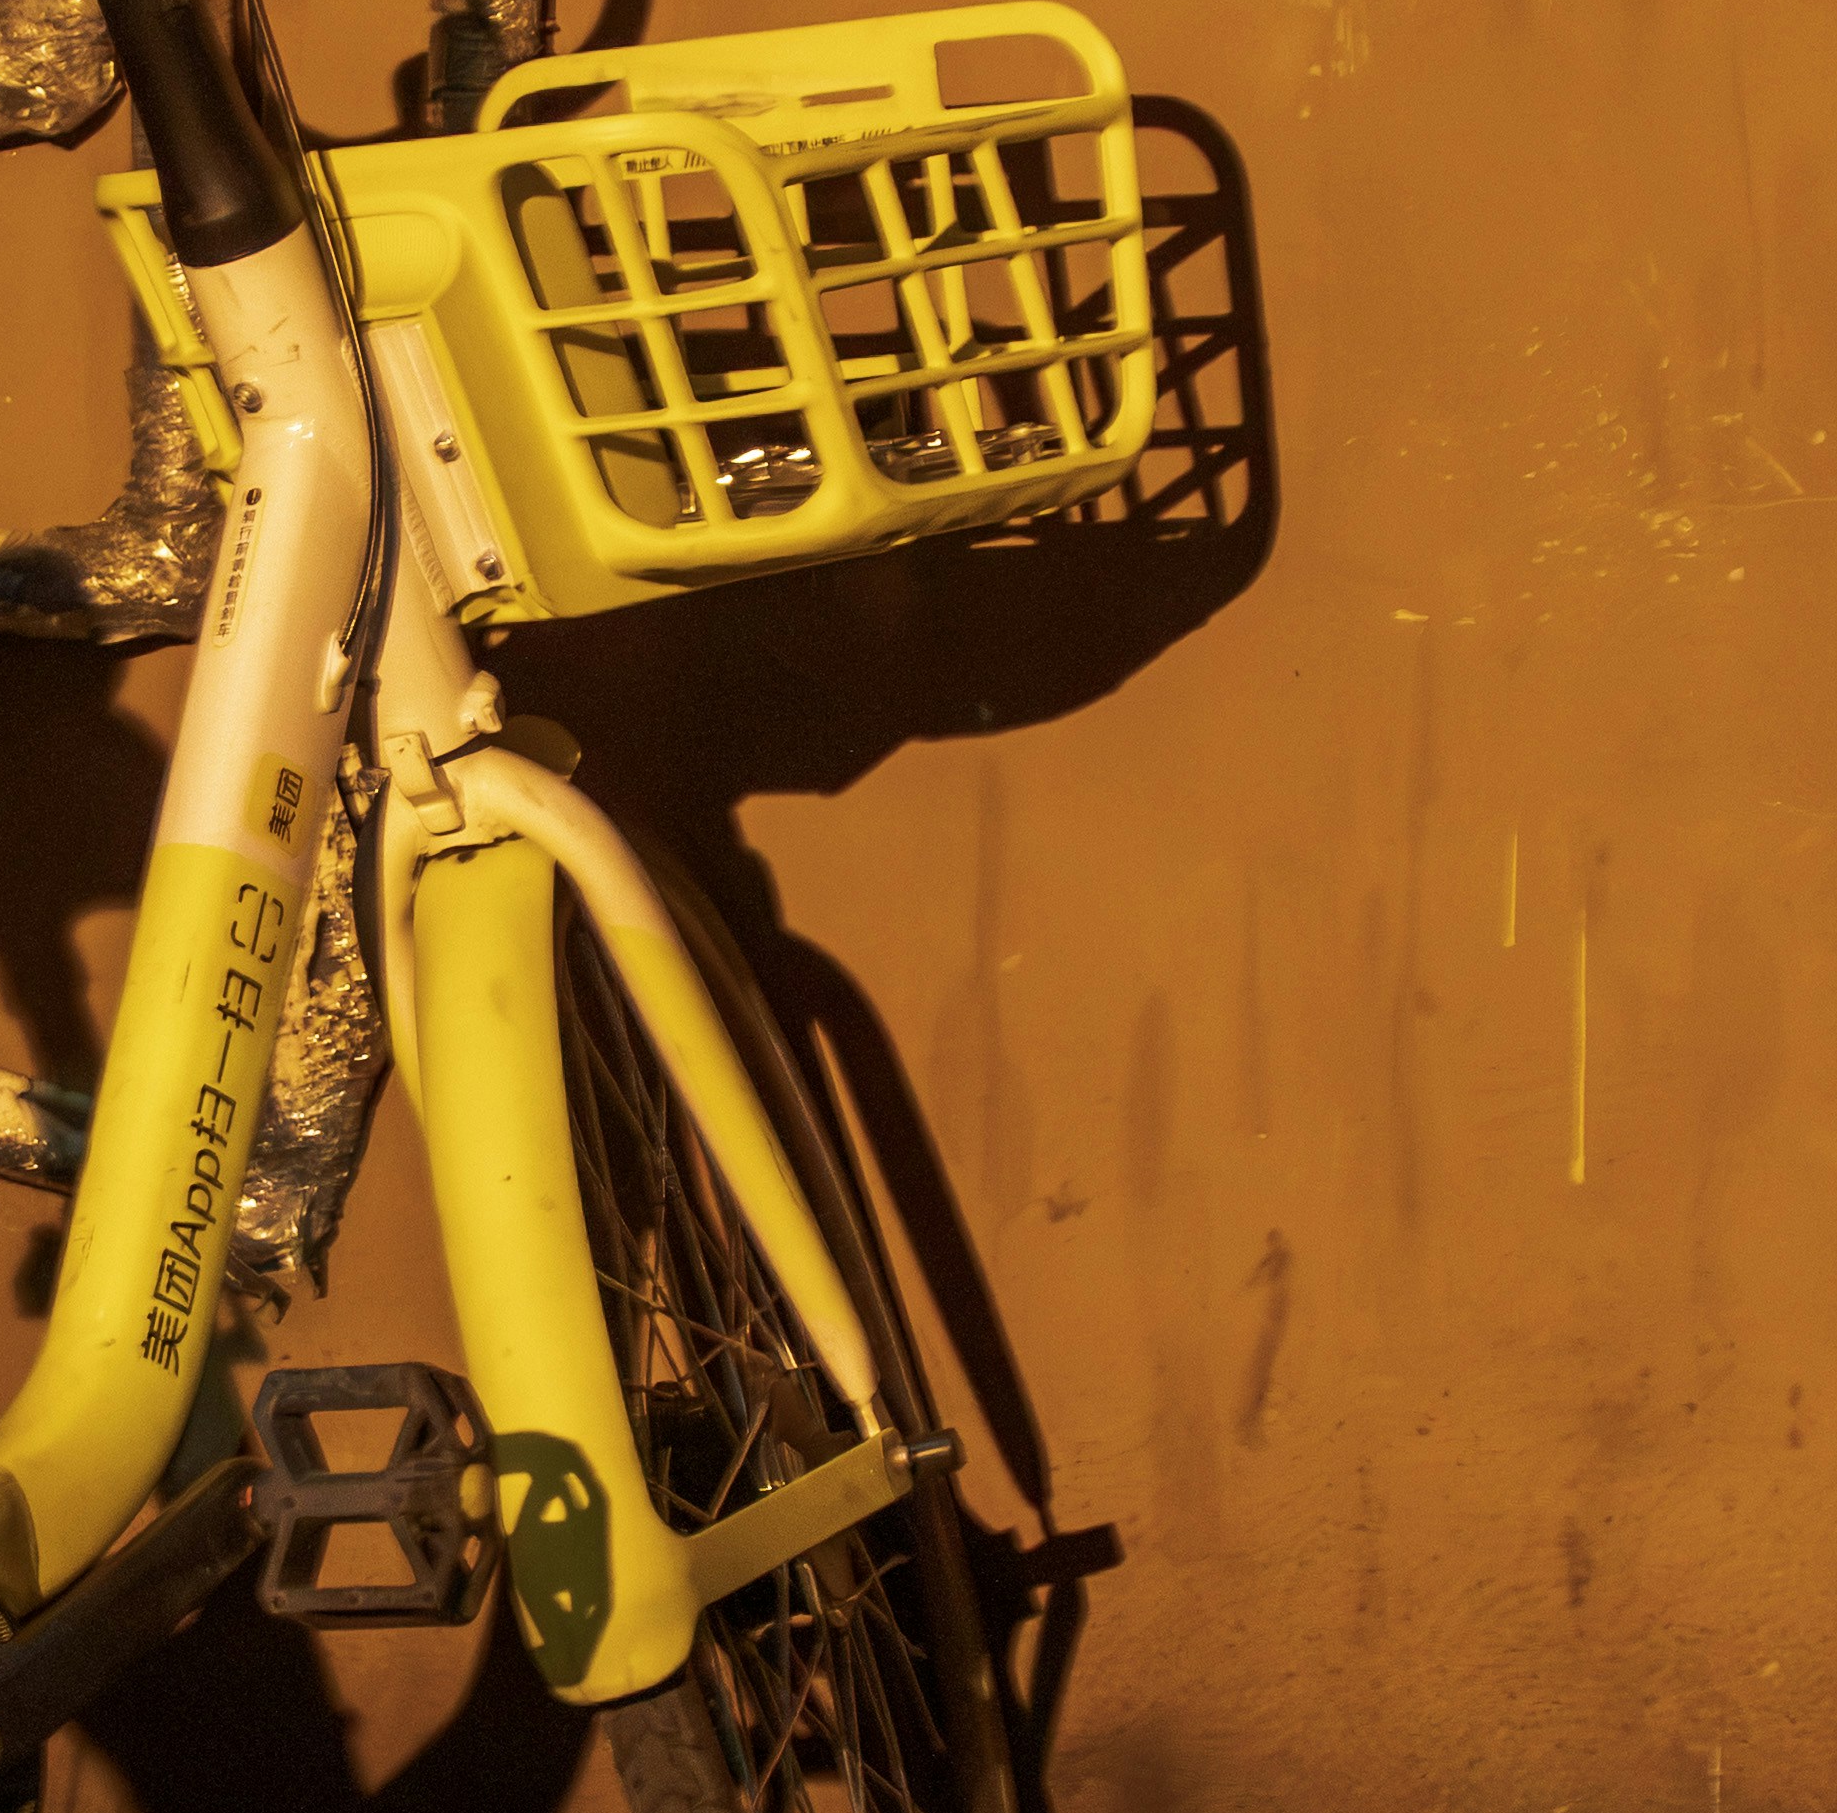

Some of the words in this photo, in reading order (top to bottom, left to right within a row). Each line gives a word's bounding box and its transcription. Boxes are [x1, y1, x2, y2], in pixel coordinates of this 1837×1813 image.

[267, 766, 304, 844] 美团
[141, 967, 263, 1376] 美团App扫一扫
